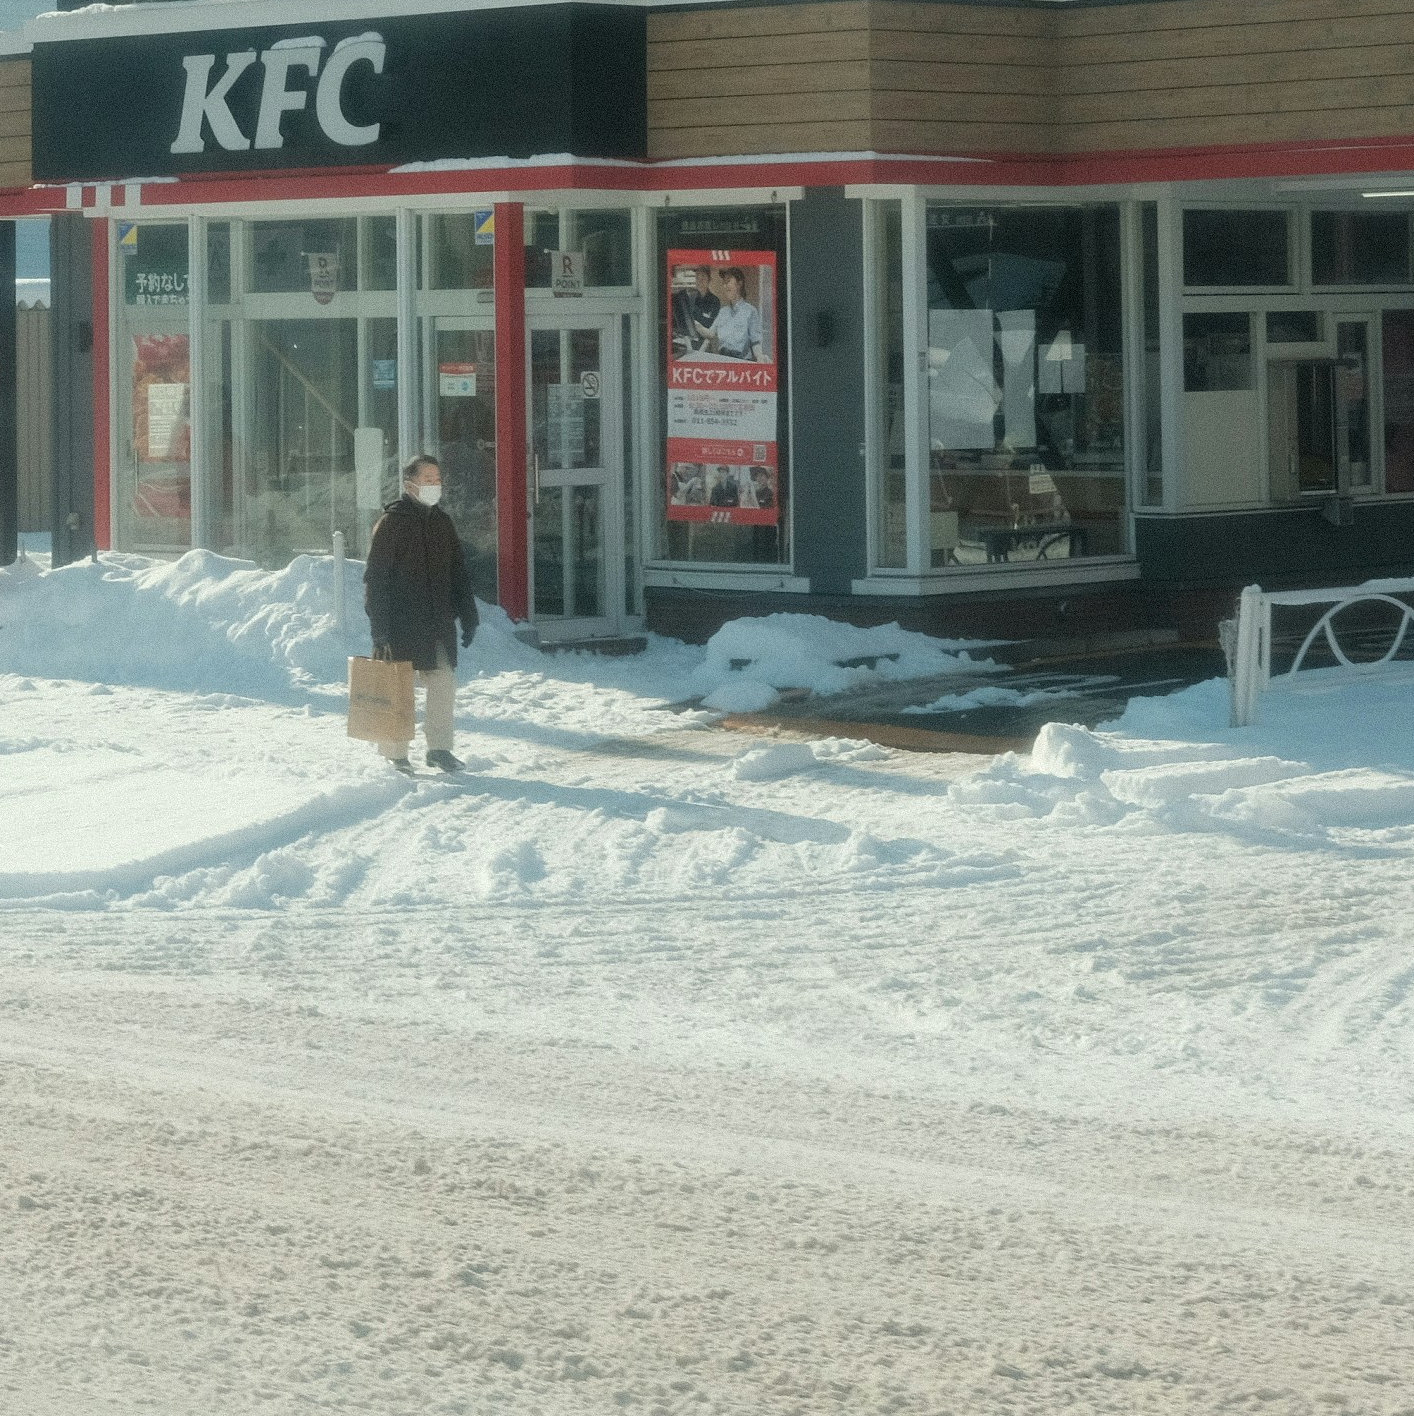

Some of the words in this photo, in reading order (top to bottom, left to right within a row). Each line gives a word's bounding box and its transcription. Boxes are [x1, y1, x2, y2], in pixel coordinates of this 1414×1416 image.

[170, 40, 387, 154] KFC
[672, 367, 772, 386] KFCでアルバイト
